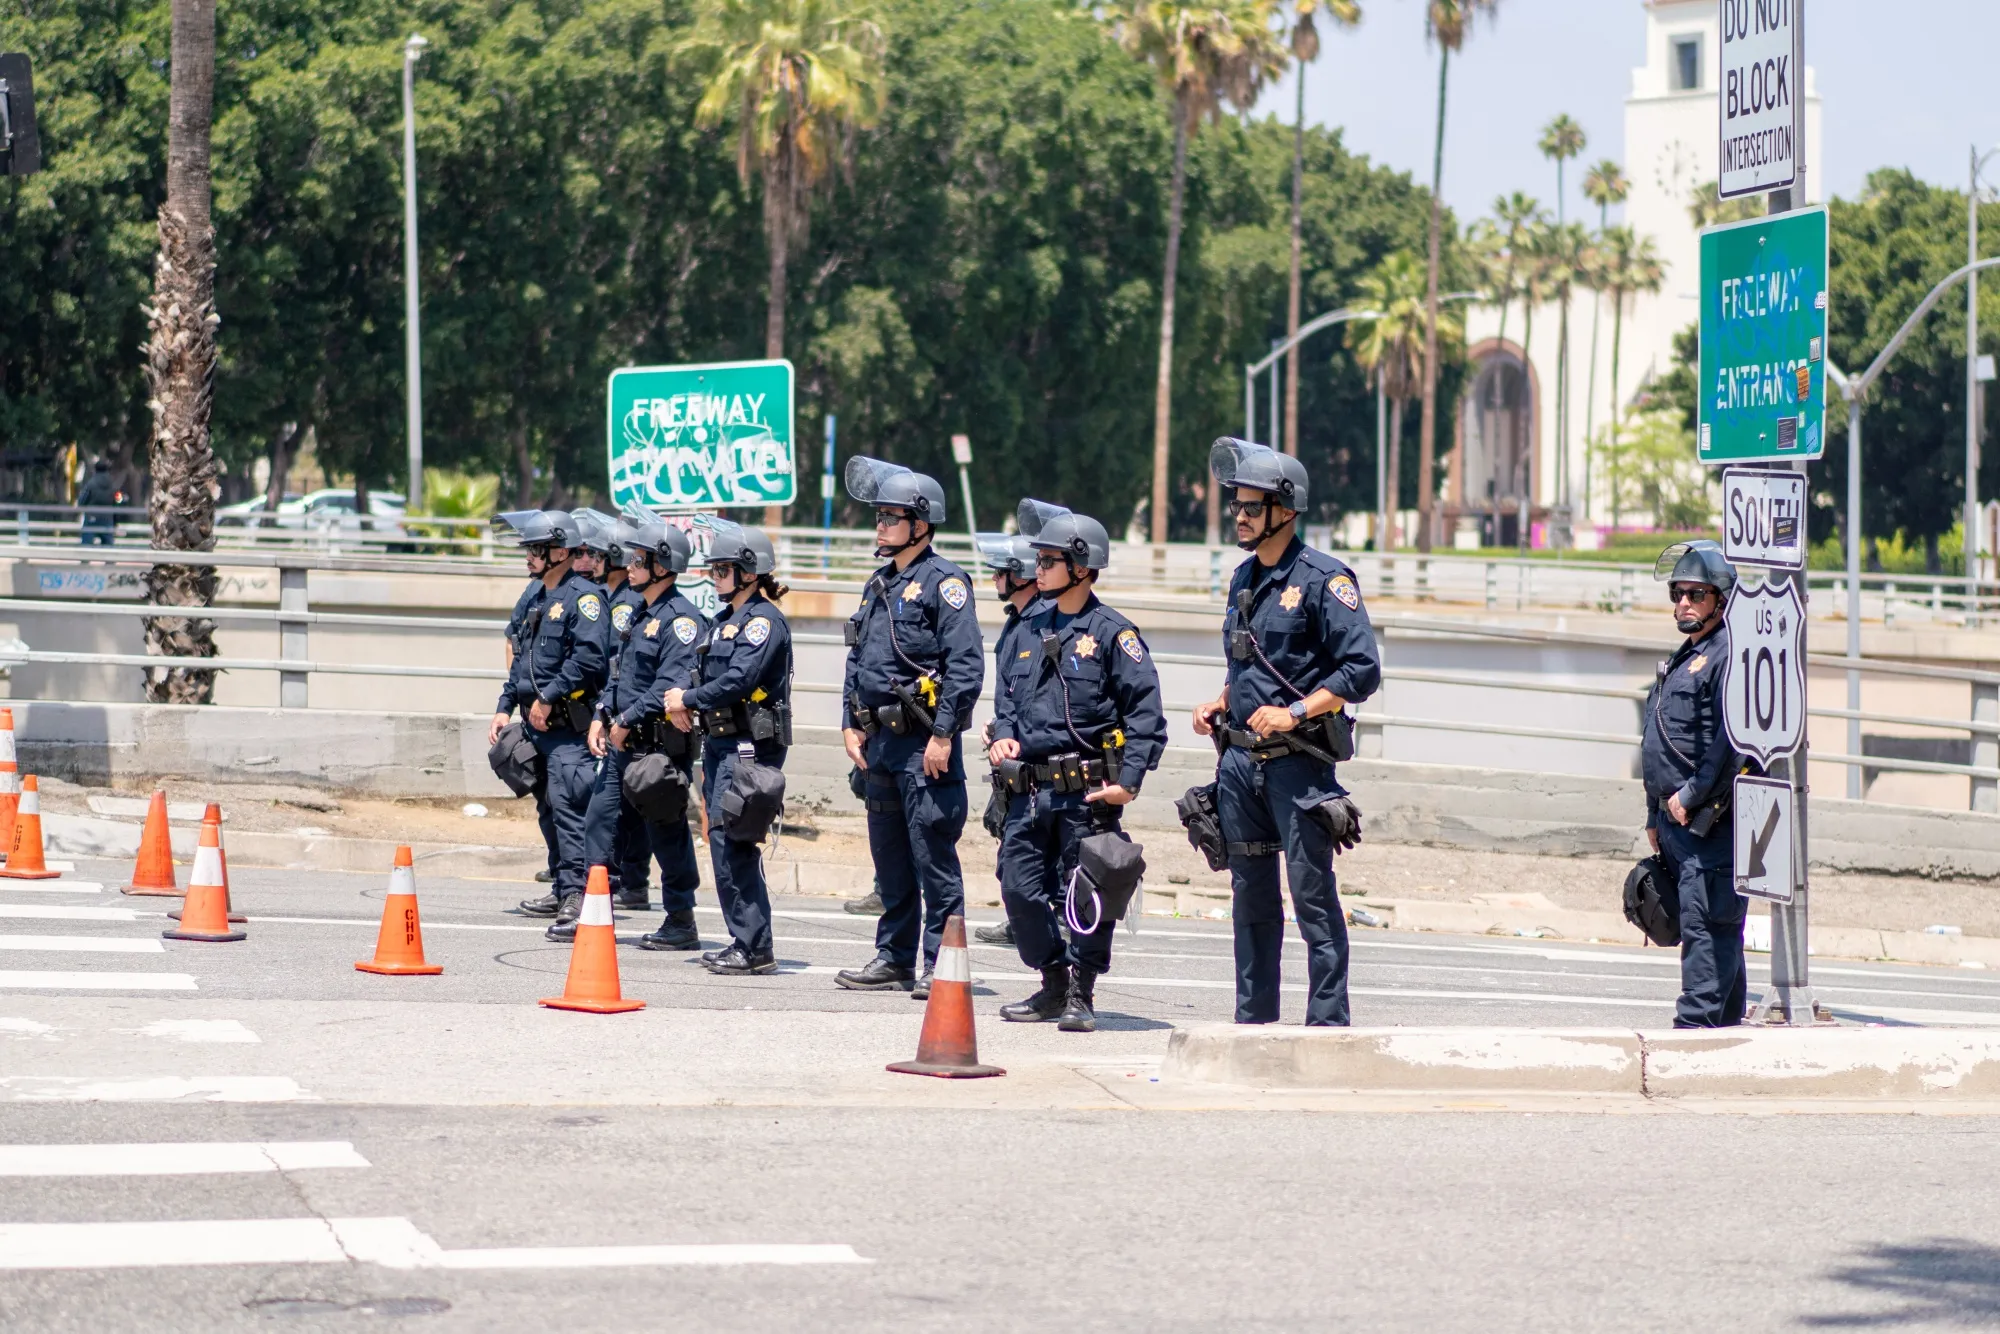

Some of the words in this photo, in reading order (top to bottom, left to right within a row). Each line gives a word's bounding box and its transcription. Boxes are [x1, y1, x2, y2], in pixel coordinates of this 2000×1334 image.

[1725, 0, 1748, 43] DO
[1727, 55, 1789, 119] BLOCK
[1723, 125, 1791, 173] INTERSECTION
[1717, 358, 1807, 409] ENTRANC
[695, 595, 716, 610] US
[1756, 609, 1772, 635] US
[1742, 646, 1787, 731] 101
[12, 824, 23, 853] CHP
[405, 909, 414, 945] CHP
